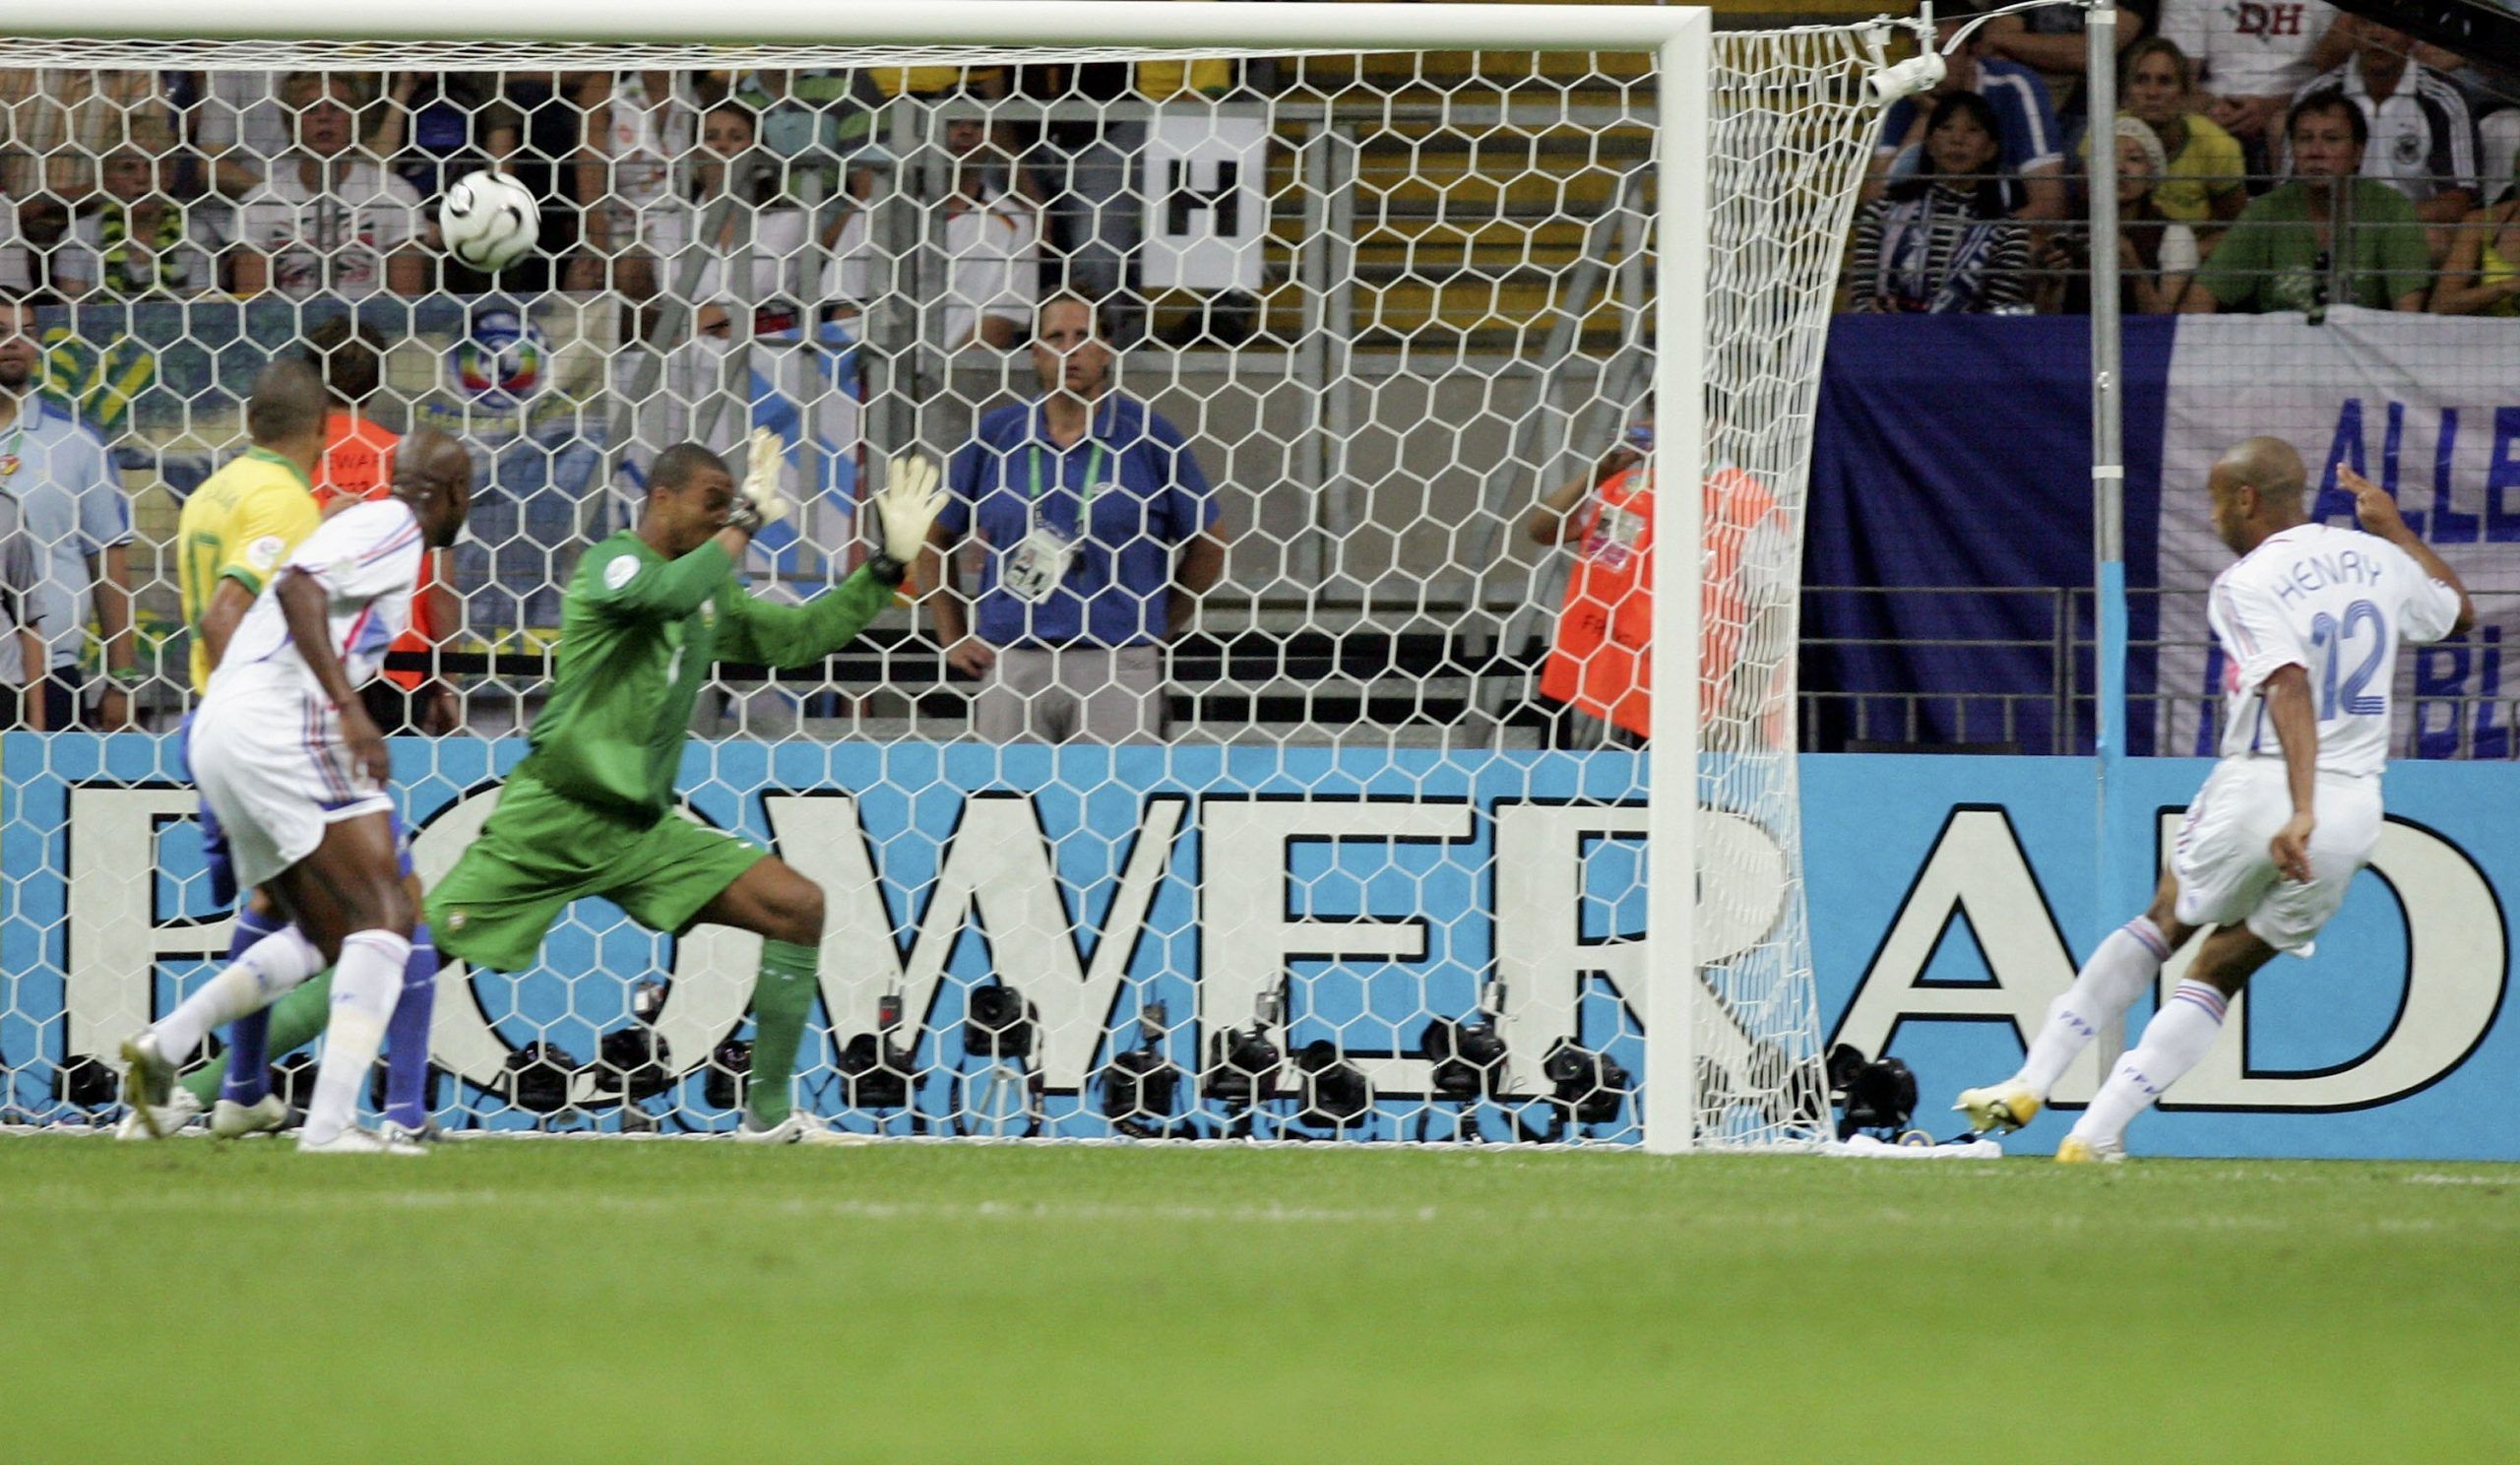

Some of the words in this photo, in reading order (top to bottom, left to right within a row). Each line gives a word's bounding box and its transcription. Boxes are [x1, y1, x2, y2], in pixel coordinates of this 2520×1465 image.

[1167, 159, 1238, 237] H
[2271, 549, 2383, 611] HENRY
[2310, 599, 2387, 722] 12
